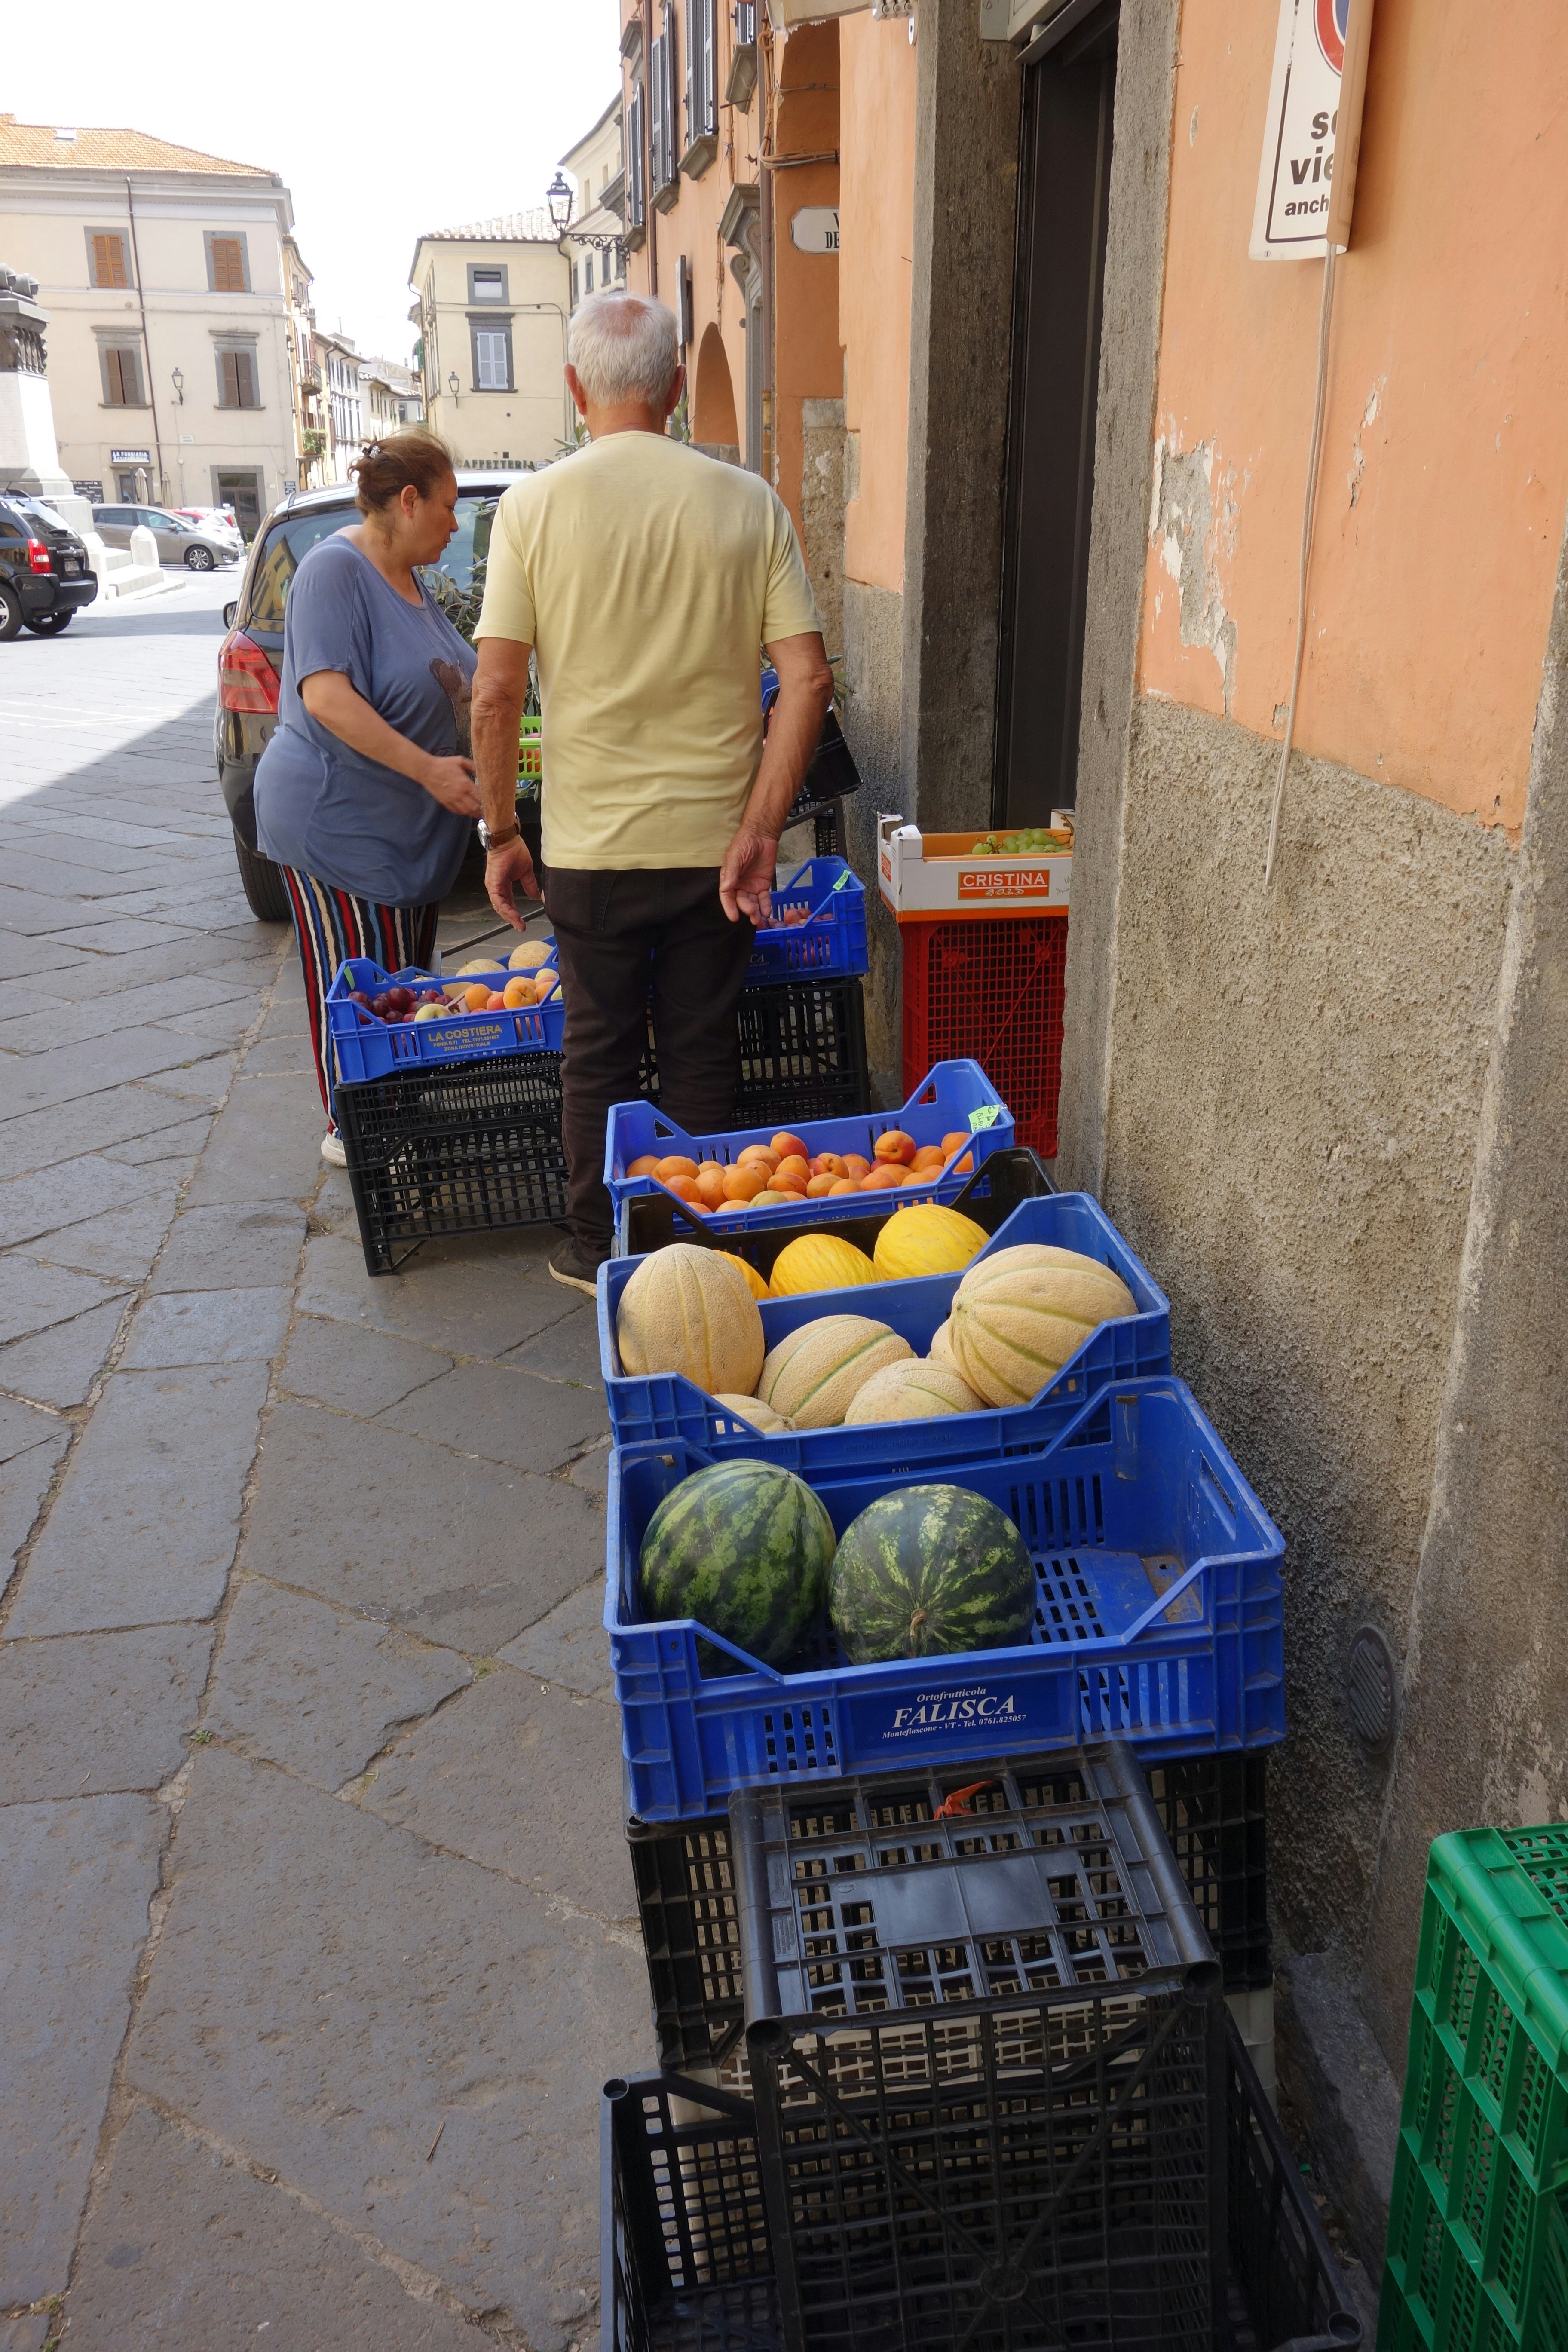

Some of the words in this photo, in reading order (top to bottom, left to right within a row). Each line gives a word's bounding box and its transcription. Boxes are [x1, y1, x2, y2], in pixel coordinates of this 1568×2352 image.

[1285, 194, 1329, 216] anch
[963, 873, 1045, 887] CRISTINA
[985, 888, 1024, 897] GOLD
[428, 1032, 444, 1042] LA
[445, 1024, 502, 1040] COSTIERA
[459, 1041, 490, 1050] INDUSTRIALE
[916, 1687, 986, 1702] Ortofrutticola
[891, 1695, 1016, 1728] FALISCA
[882, 1726, 937, 1739] Montefiascone
[978, 1714, 1026, 1726] 0761.825057
